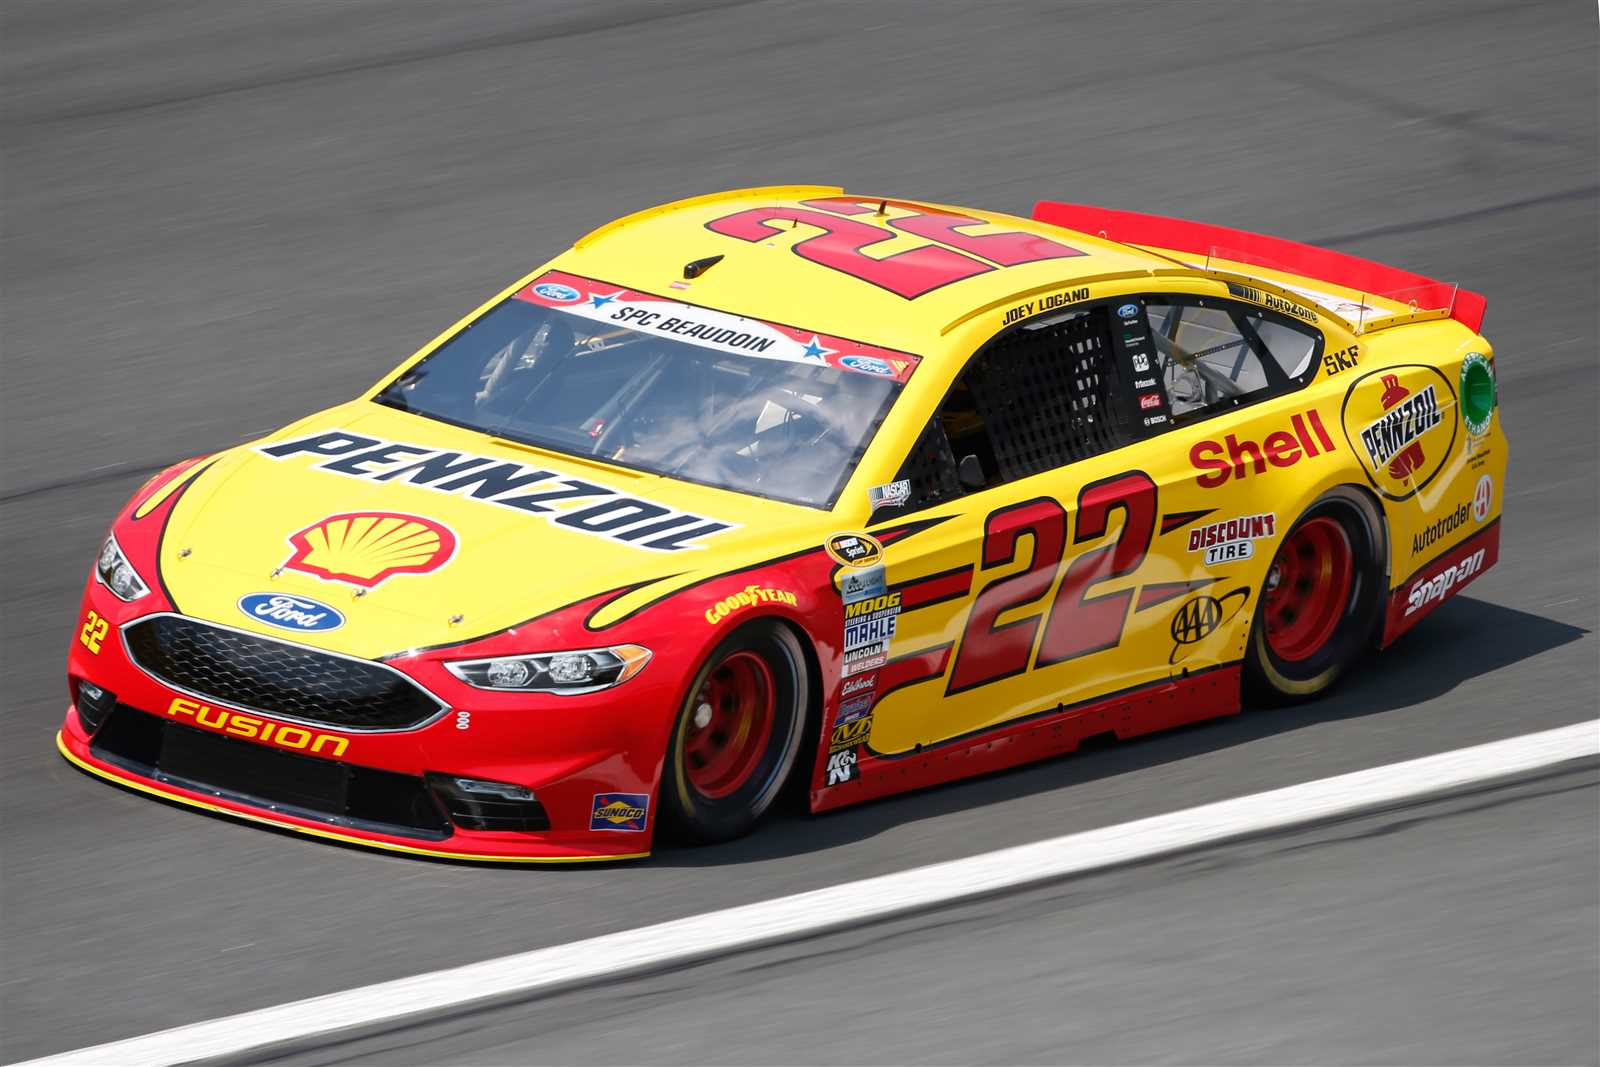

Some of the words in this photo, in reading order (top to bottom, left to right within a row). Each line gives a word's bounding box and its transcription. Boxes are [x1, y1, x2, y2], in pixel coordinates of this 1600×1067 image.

[703, 196, 1091, 301] 22
[1002, 302, 1035, 326] JOEY
[1039, 288, 1089, 310] LOGANO
[610, 306, 660, 327] SPC
[661, 314, 776, 352] BEAUDOIN
[846, 358, 889, 374] Ford
[1324, 345, 1360, 376] SKF
[1361, 386, 1440, 470] PENNZOIL
[1189, 410, 1336, 488] Shell
[264, 432, 729, 551] PENNZOIL
[1188, 515, 1275, 551] DISCOUNT
[1412, 502, 1471, 557] Autotrader
[1209, 543, 1247, 561] TIRE
[944, 469, 1158, 697] 22
[255, 596, 327, 627] Ford
[705, 585, 798, 624] GOODYEAR
[845, 593, 901, 618] MOOG
[80, 610, 109, 655] 22
[846, 617, 895, 648] MAHLE
[845, 644, 881, 663] LINCOLN
[852, 656, 885, 673] WELDERS
[167, 698, 350, 757] FUSION
[594, 808, 643, 818] SUNOCO
